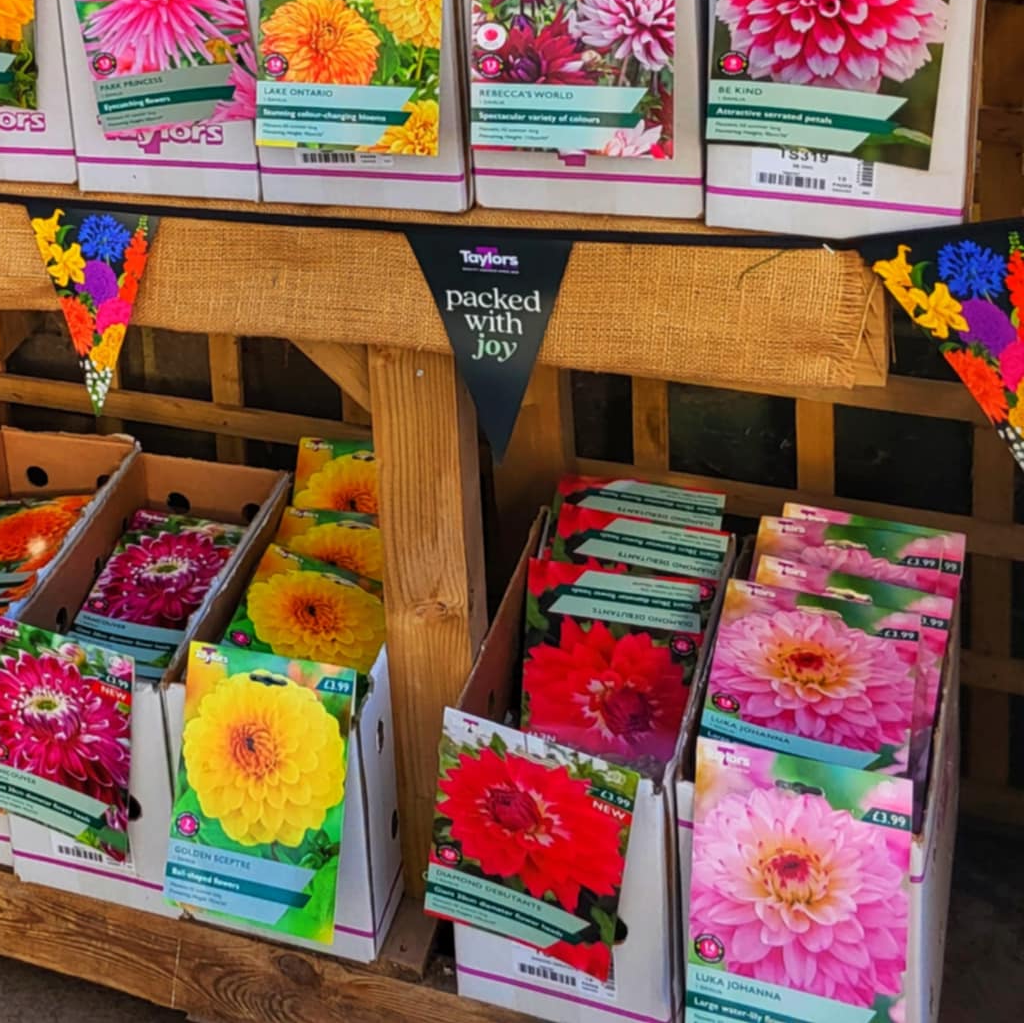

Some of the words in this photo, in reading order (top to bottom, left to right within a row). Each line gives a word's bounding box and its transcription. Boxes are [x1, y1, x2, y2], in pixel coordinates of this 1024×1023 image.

[100, 79, 122, 91] PARK
[718, 86, 731, 95] BE
[734, 87, 762, 96] KIND
[264, 87, 287, 96] LAKE
[290, 88, 333, 98] ONTARIO
[479, 89, 532, 99] REBECCA'S
[534, 90, 574, 100] WORLD
[148, 96, 171, 106] flowers
[479, 112, 527, 123] Spectacular
[528, 113, 557, 123] variety
[559, 114, 568, 123] of
[569, 115, 600, 124] colours
[716, 107, 762, 118] Attractive
[764, 111, 802, 121] serrated
[805, 114, 833, 125] petals
[460, 249, 519, 267] Taylors
[446, 287, 541, 313] packed
[464, 311, 523, 335] with
[472, 333, 517, 362] joy
[100, 686, 126, 700] NEW
[324, 681, 350, 692] £3.99
[710, 715, 737, 729] LUKA
[592, 801, 625, 820] NEW
[873, 811, 906, 827] £3.99
[174, 845, 211, 861] GOLDEN
[213, 855, 251, 870] SCEPTRE
[695, 973, 725, 987] LUKA
[726, 977, 782, 1001] JOHANNA
[693, 997, 720, 1011] Large
